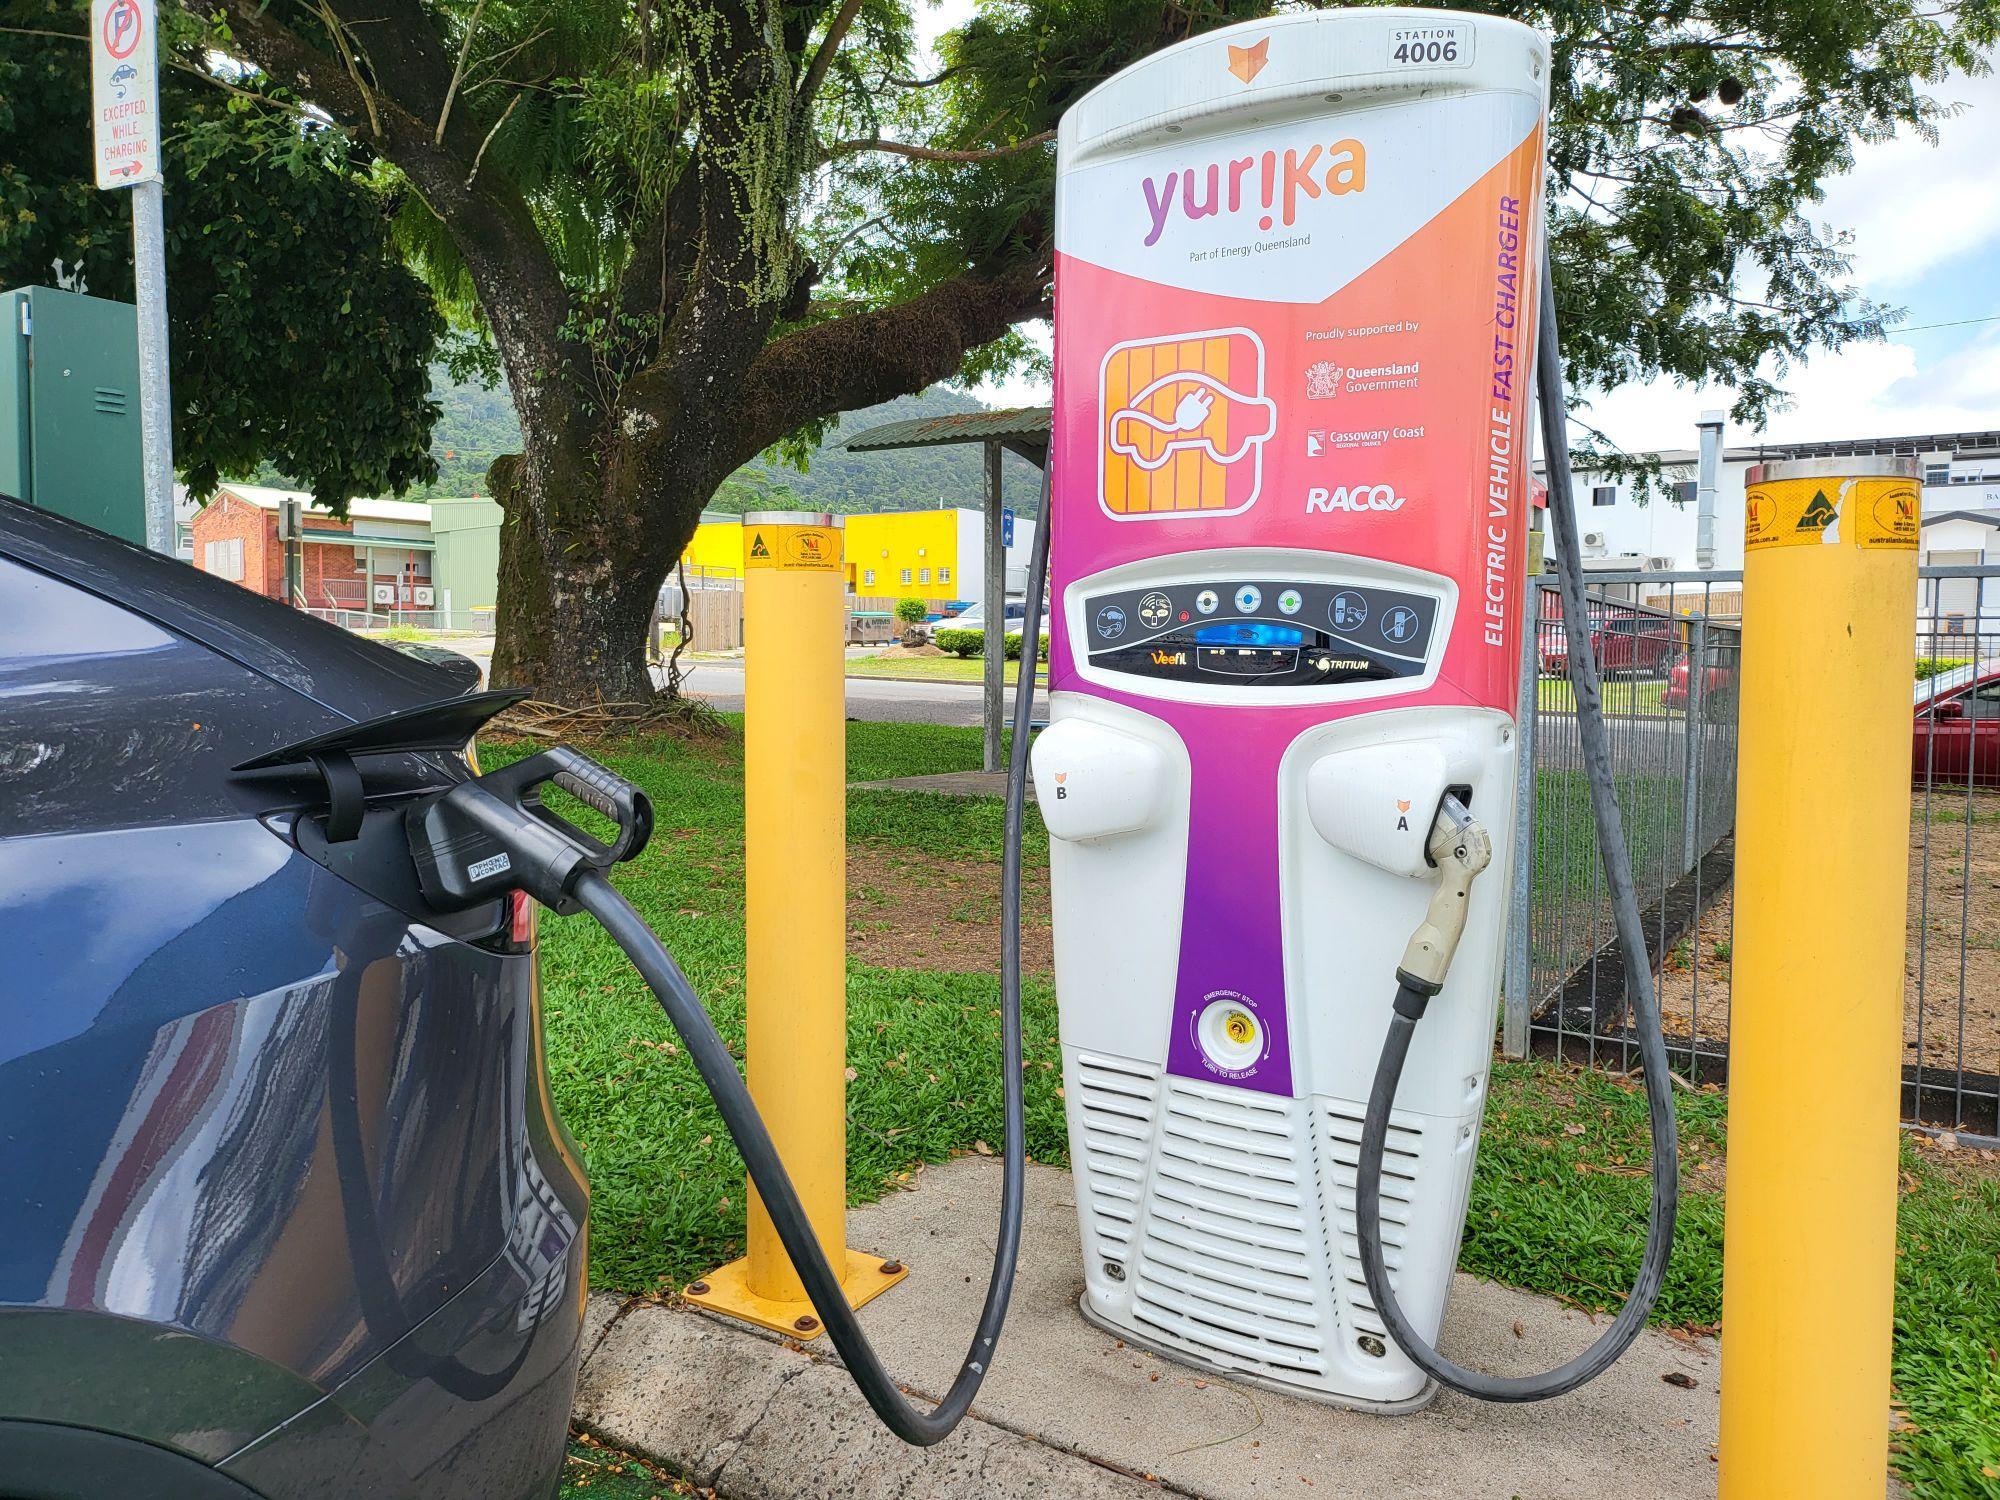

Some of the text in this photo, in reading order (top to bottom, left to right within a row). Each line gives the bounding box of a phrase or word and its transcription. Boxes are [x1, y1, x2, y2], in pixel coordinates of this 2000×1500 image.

[1395, 29, 1455, 41] STATION
[1393, 41, 1457, 63] 4006
[103, 100, 146, 122] EXCEPTED
[112, 121, 138, 139] WHILE
[104, 139, 147, 161] CHARGING
[1189, 233, 1311, 262] Part of Energy Queensland
[1306, 320, 1419, 341] Proudly supported by
[1346, 362, 1419, 380] Queensland
[1346, 376, 1419, 393] Government
[1484, 196, 1519, 647] ELECTRIC VEHICLE FAST CHARGER
[1330, 426, 1424, 442] Cassowary Coast
[1305, 484, 1407, 514] RACQ
[1151, 650, 1187, 665] Veefil
[1330, 660, 1369, 670] TRITIUM
[1056, 787, 1067, 800] B
[1396, 816, 1409, 832] A
[480, 860, 509, 875] CONTACT
[1203, 989, 1258, 1008] EMERGENCY STOP
[1201, 1058, 1258, 1080] TURN TO RELEASE
